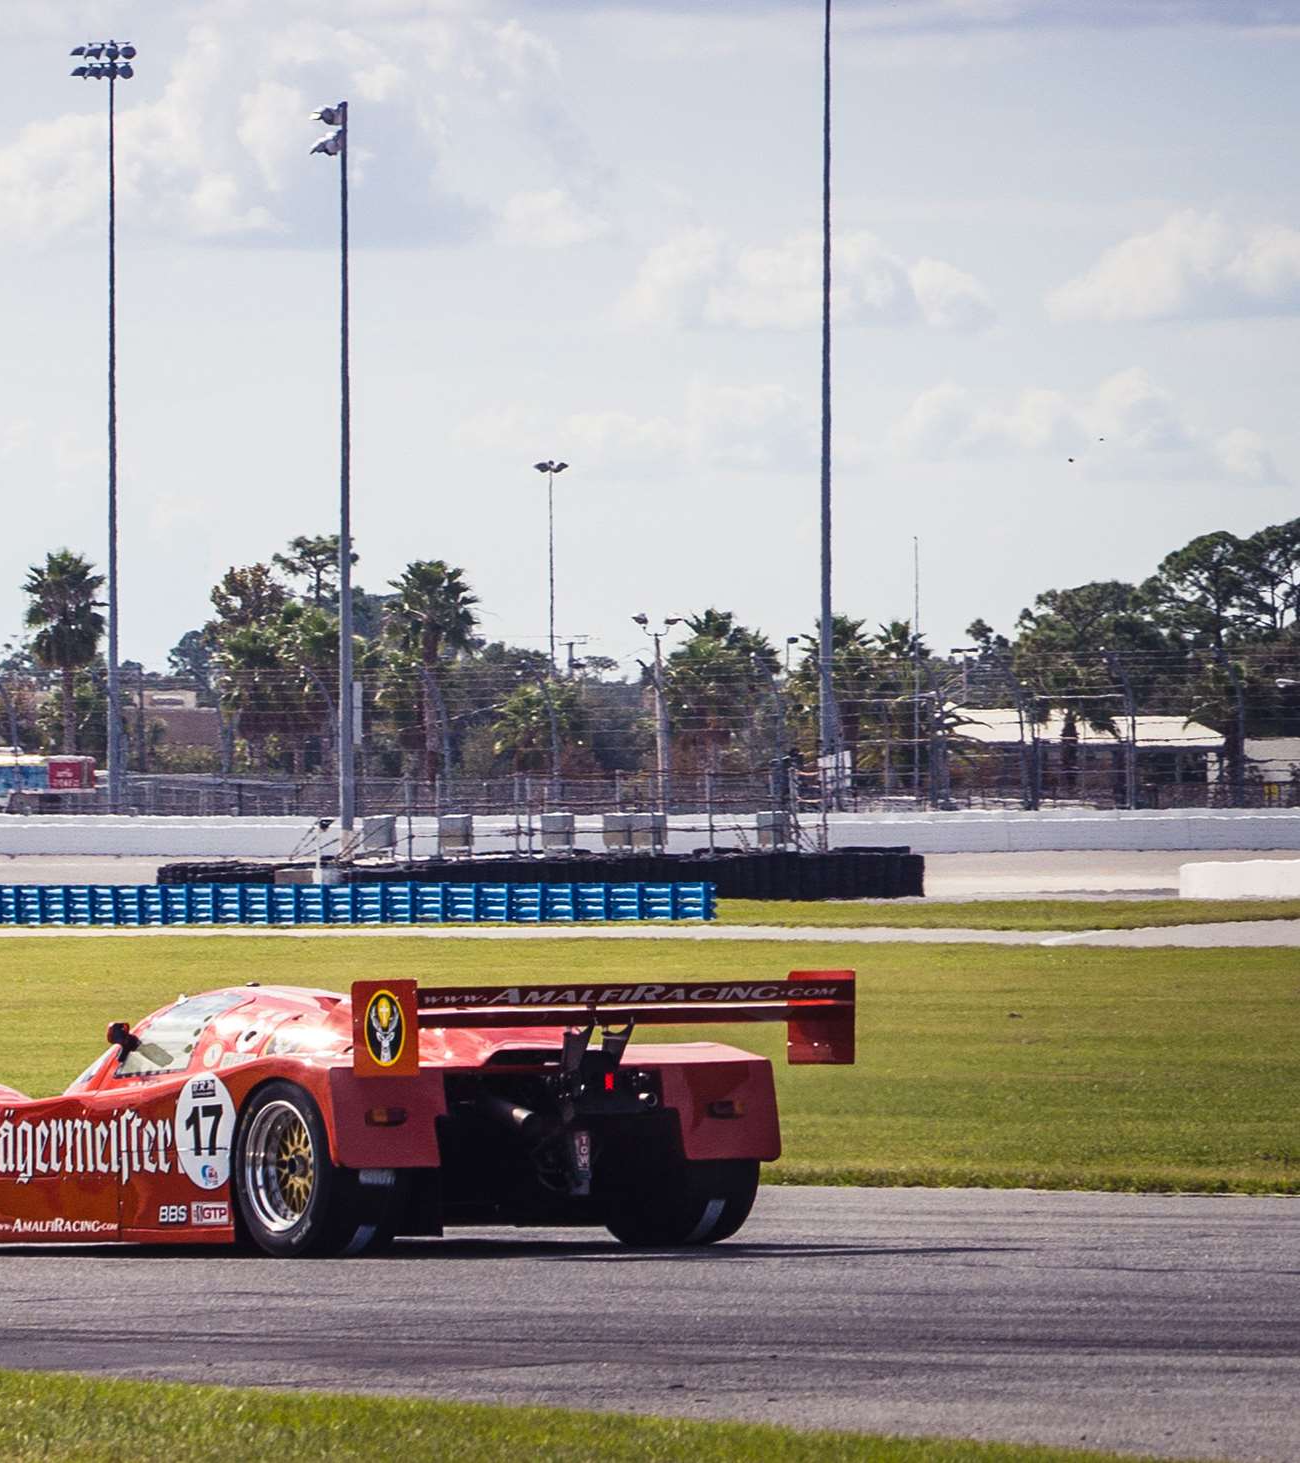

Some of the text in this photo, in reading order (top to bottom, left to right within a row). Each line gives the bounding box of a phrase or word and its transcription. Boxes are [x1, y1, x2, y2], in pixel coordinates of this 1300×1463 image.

[185, 1104, 223, 1156] 17
[158, 1205, 187, 1223] BBS
[203, 1206, 227, 1219] GTP
